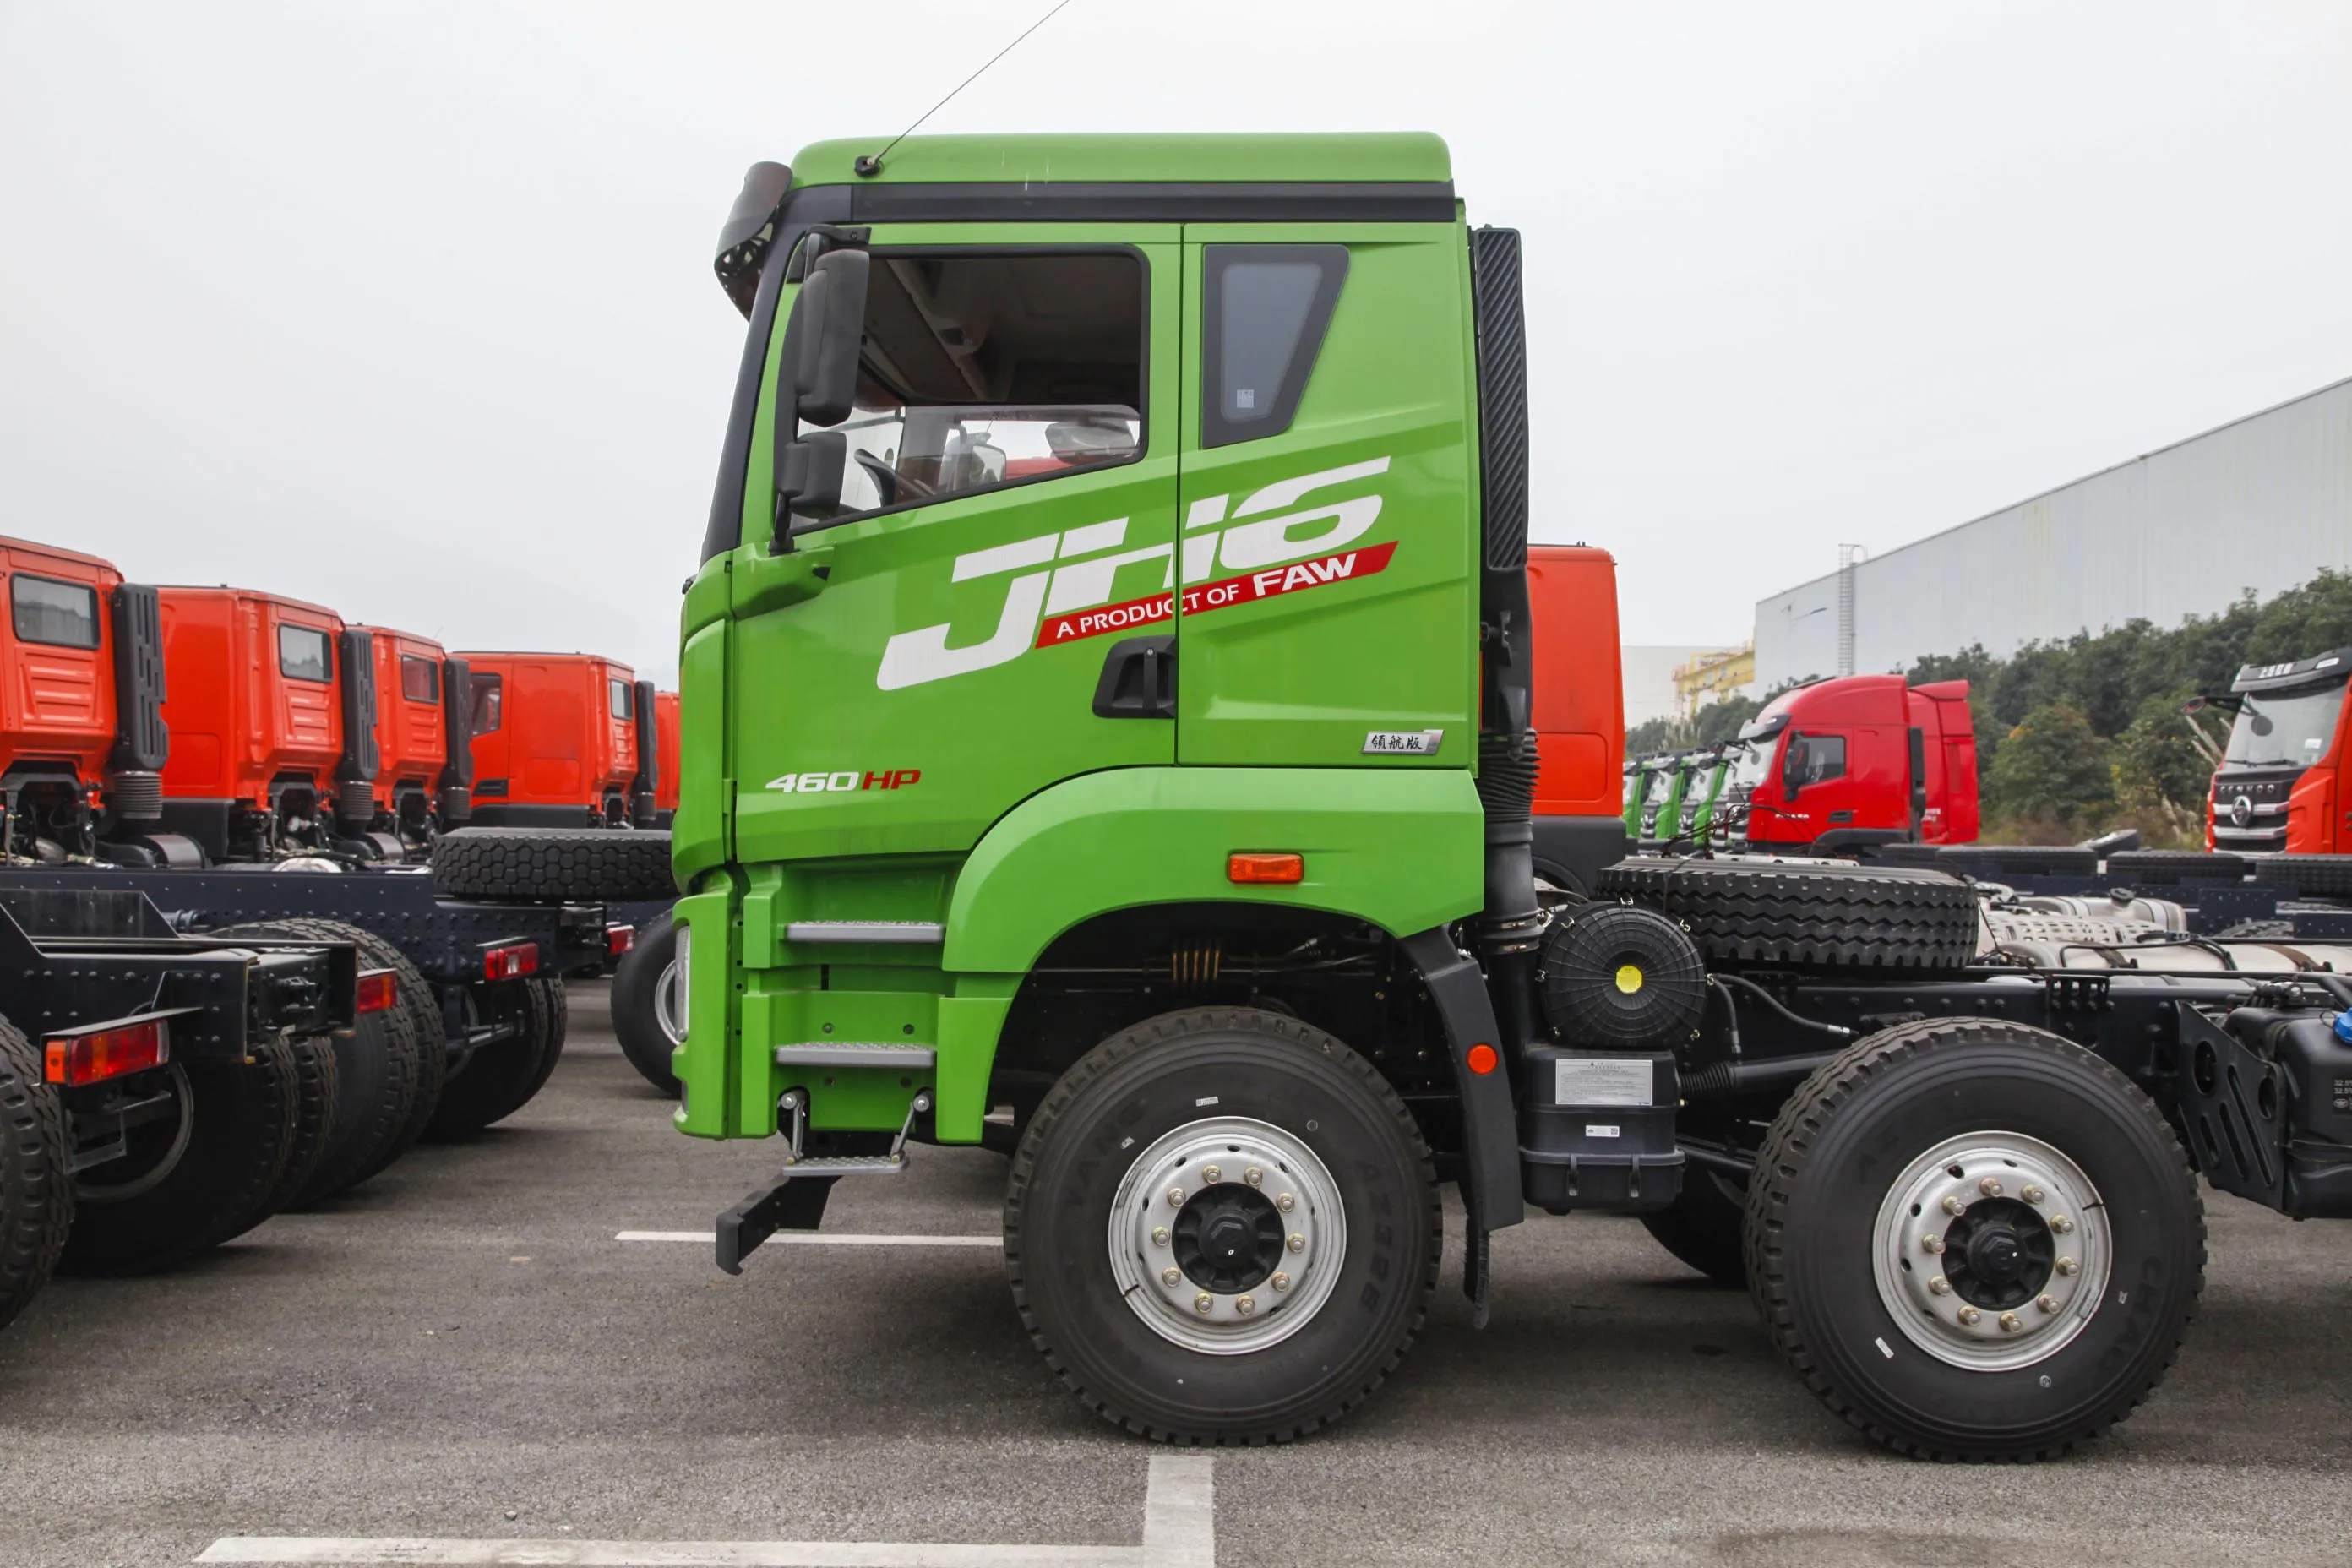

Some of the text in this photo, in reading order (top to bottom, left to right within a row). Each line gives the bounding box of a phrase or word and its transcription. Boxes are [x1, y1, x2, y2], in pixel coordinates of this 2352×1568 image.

[876, 455, 1391, 691] JH6
[1056, 553, 1357, 638] A PRODUCT OF FAW
[765, 770, 922, 793] 460 HP
